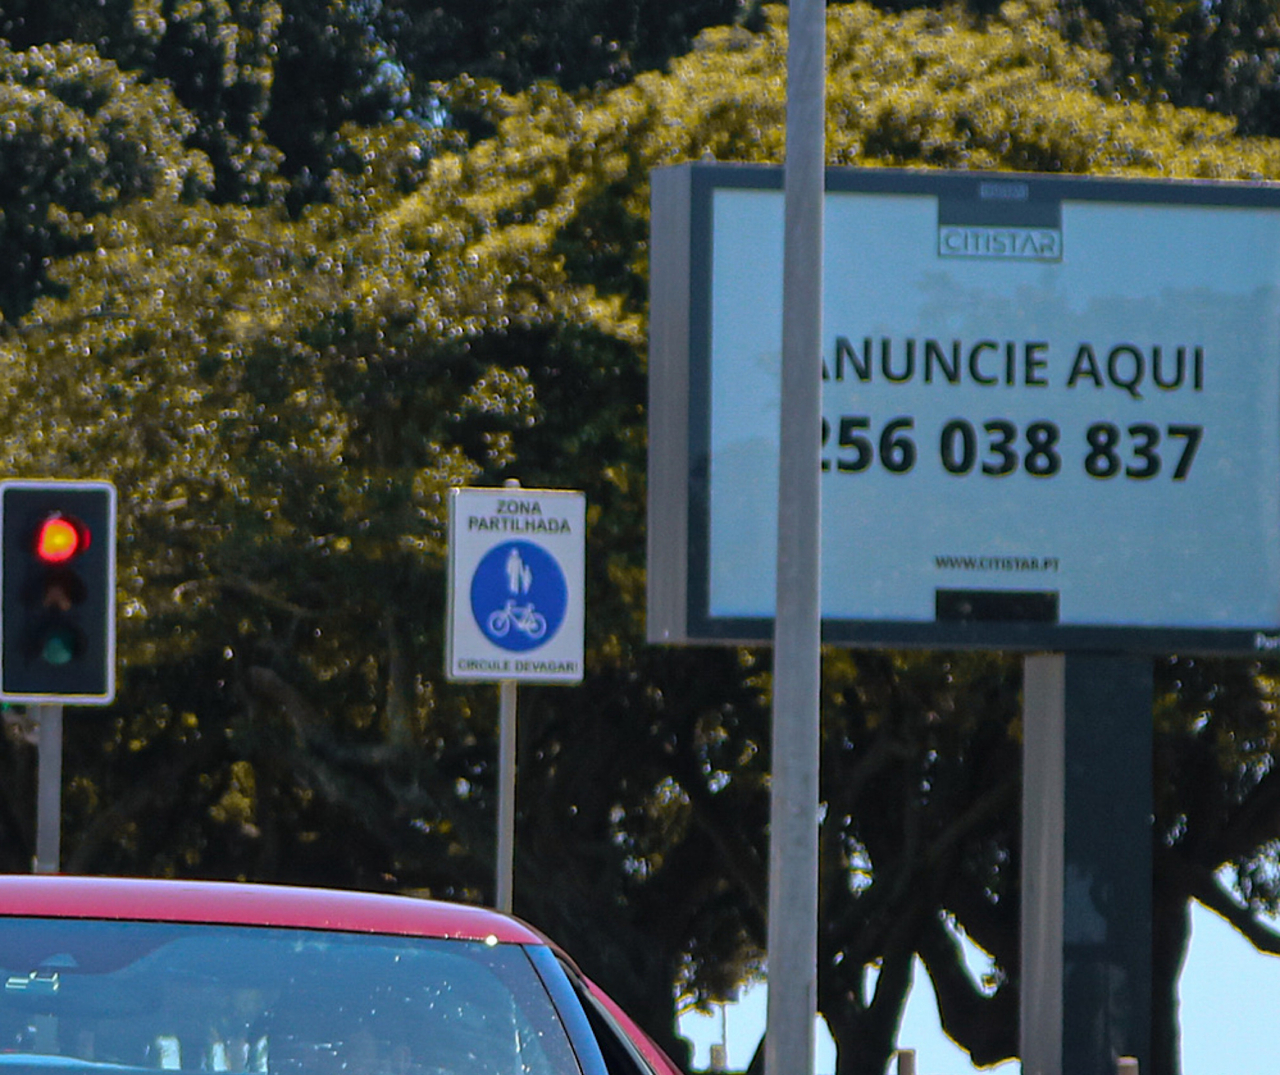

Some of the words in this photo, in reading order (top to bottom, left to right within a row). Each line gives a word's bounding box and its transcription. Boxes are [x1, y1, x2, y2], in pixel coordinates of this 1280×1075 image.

[943, 230, 1057, 255] CITISTAR
[822, 336, 1050, 388] NUNCIE
[1066, 343, 1205, 399] AQUI
[822, 415, 918, 474] 56
[939, 419, 1062, 478] 038
[1084, 424, 1205, 481] 837
[496, 499, 542, 515] ZONA
[467, 516, 571, 534] PARTILHADA
